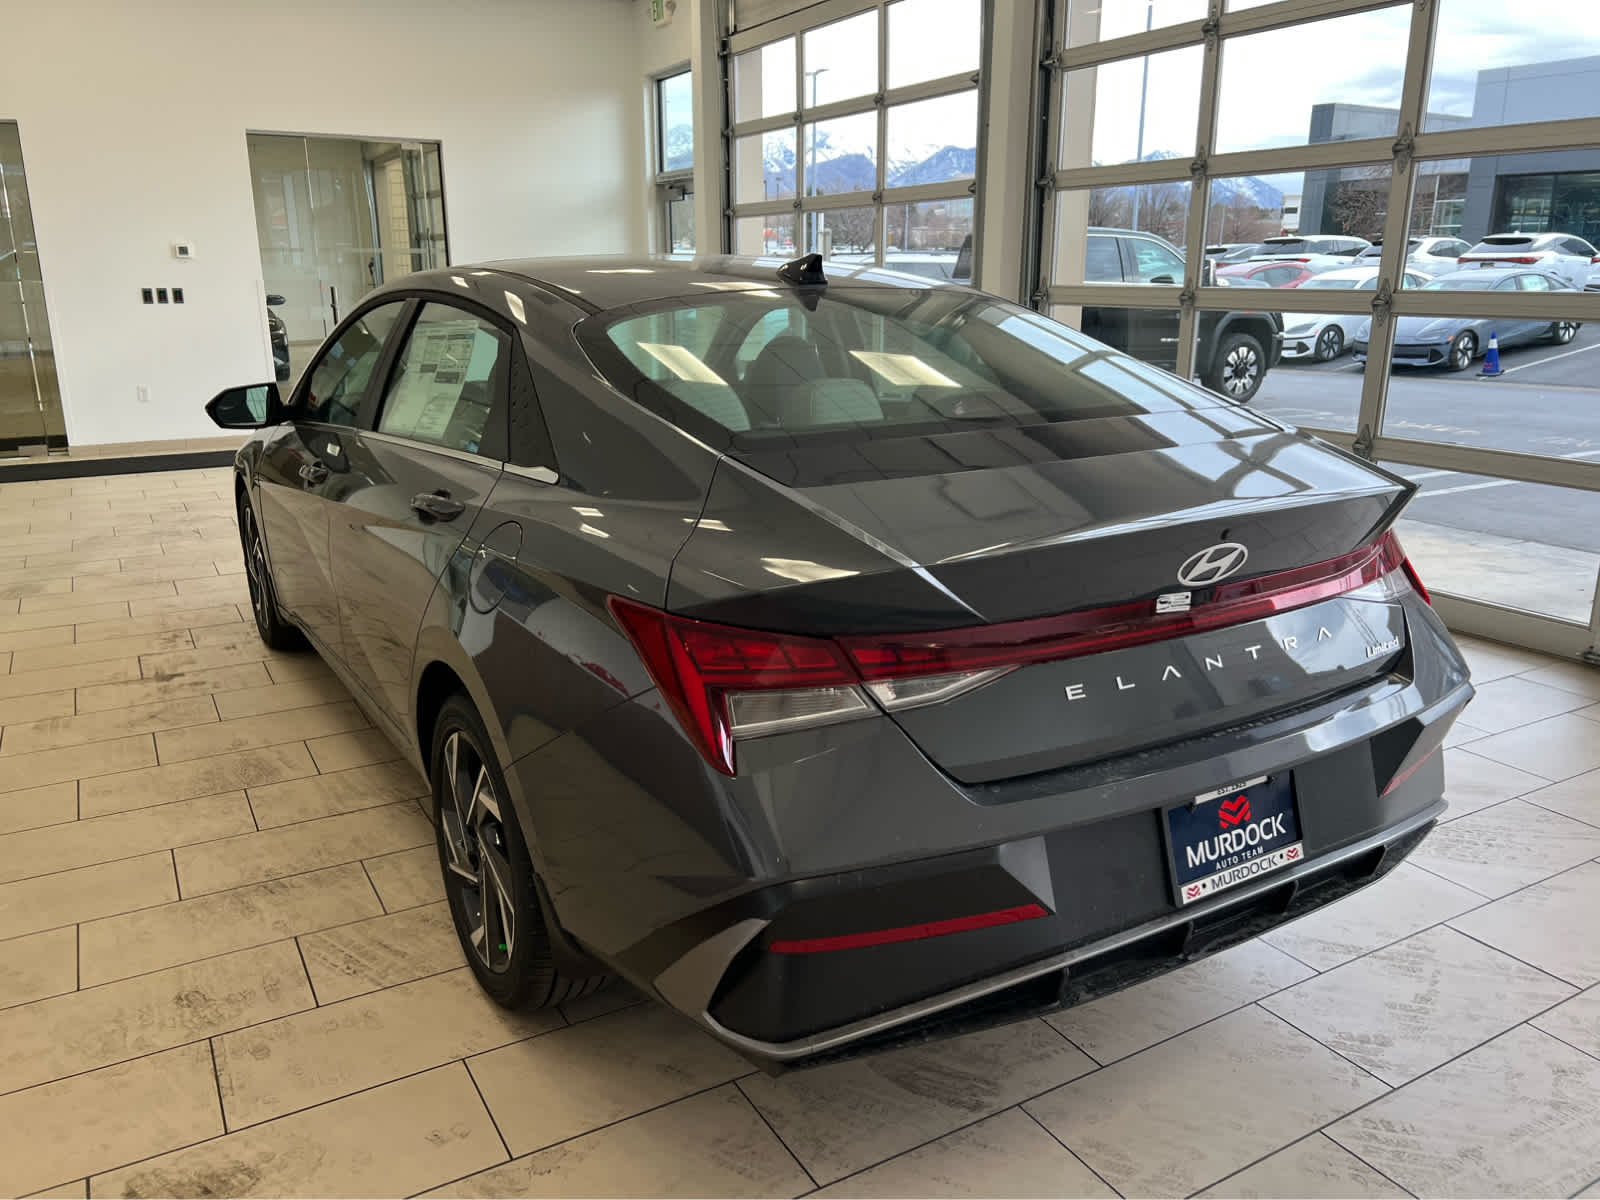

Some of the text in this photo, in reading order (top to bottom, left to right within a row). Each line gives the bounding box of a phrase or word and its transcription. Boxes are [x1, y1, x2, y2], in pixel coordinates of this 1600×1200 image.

[1065, 626, 1332, 701] ELANTRA
[1365, 635, 1399, 659] Limited
[1185, 812, 1287, 869] MURDOCK
[1215, 846, 1264, 871] AUTO TEAM
[1211, 854, 1278, 891] MURDOCK
